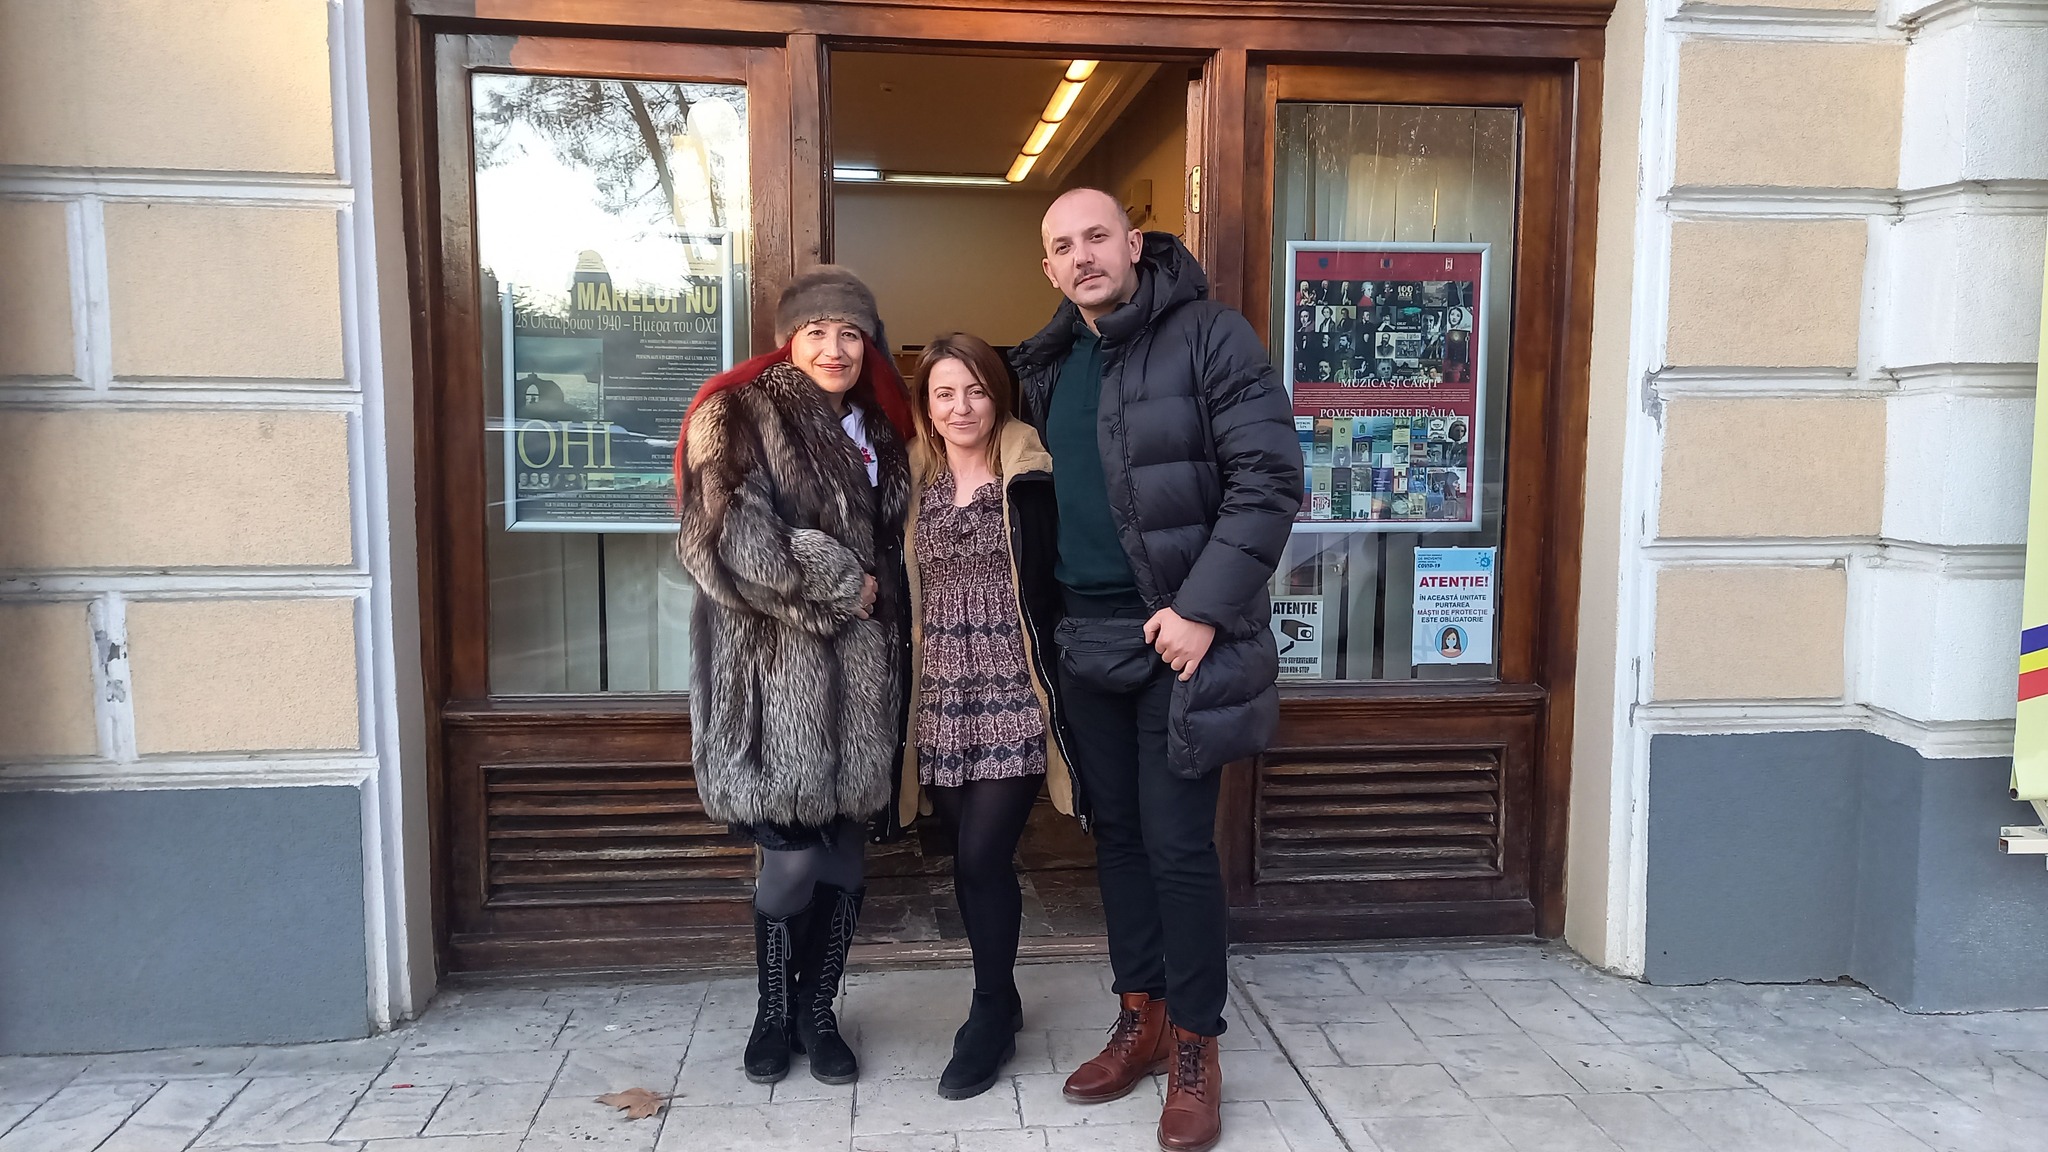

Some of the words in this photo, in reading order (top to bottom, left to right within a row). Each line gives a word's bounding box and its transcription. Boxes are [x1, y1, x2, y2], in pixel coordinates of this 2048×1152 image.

[686, 285, 717, 314] NU
[515, 314, 528, 328] 28
[597, 315, 621, 331] 1940
[1370, 408, 1412, 418] DESPRE
[1415, 406, 1457, 418] BRĂILA
[517, 419, 616, 469] OHI
[1419, 576, 1489, 590] ATENȚIE!
[1272, 602, 1318, 618] ATENȚIE
